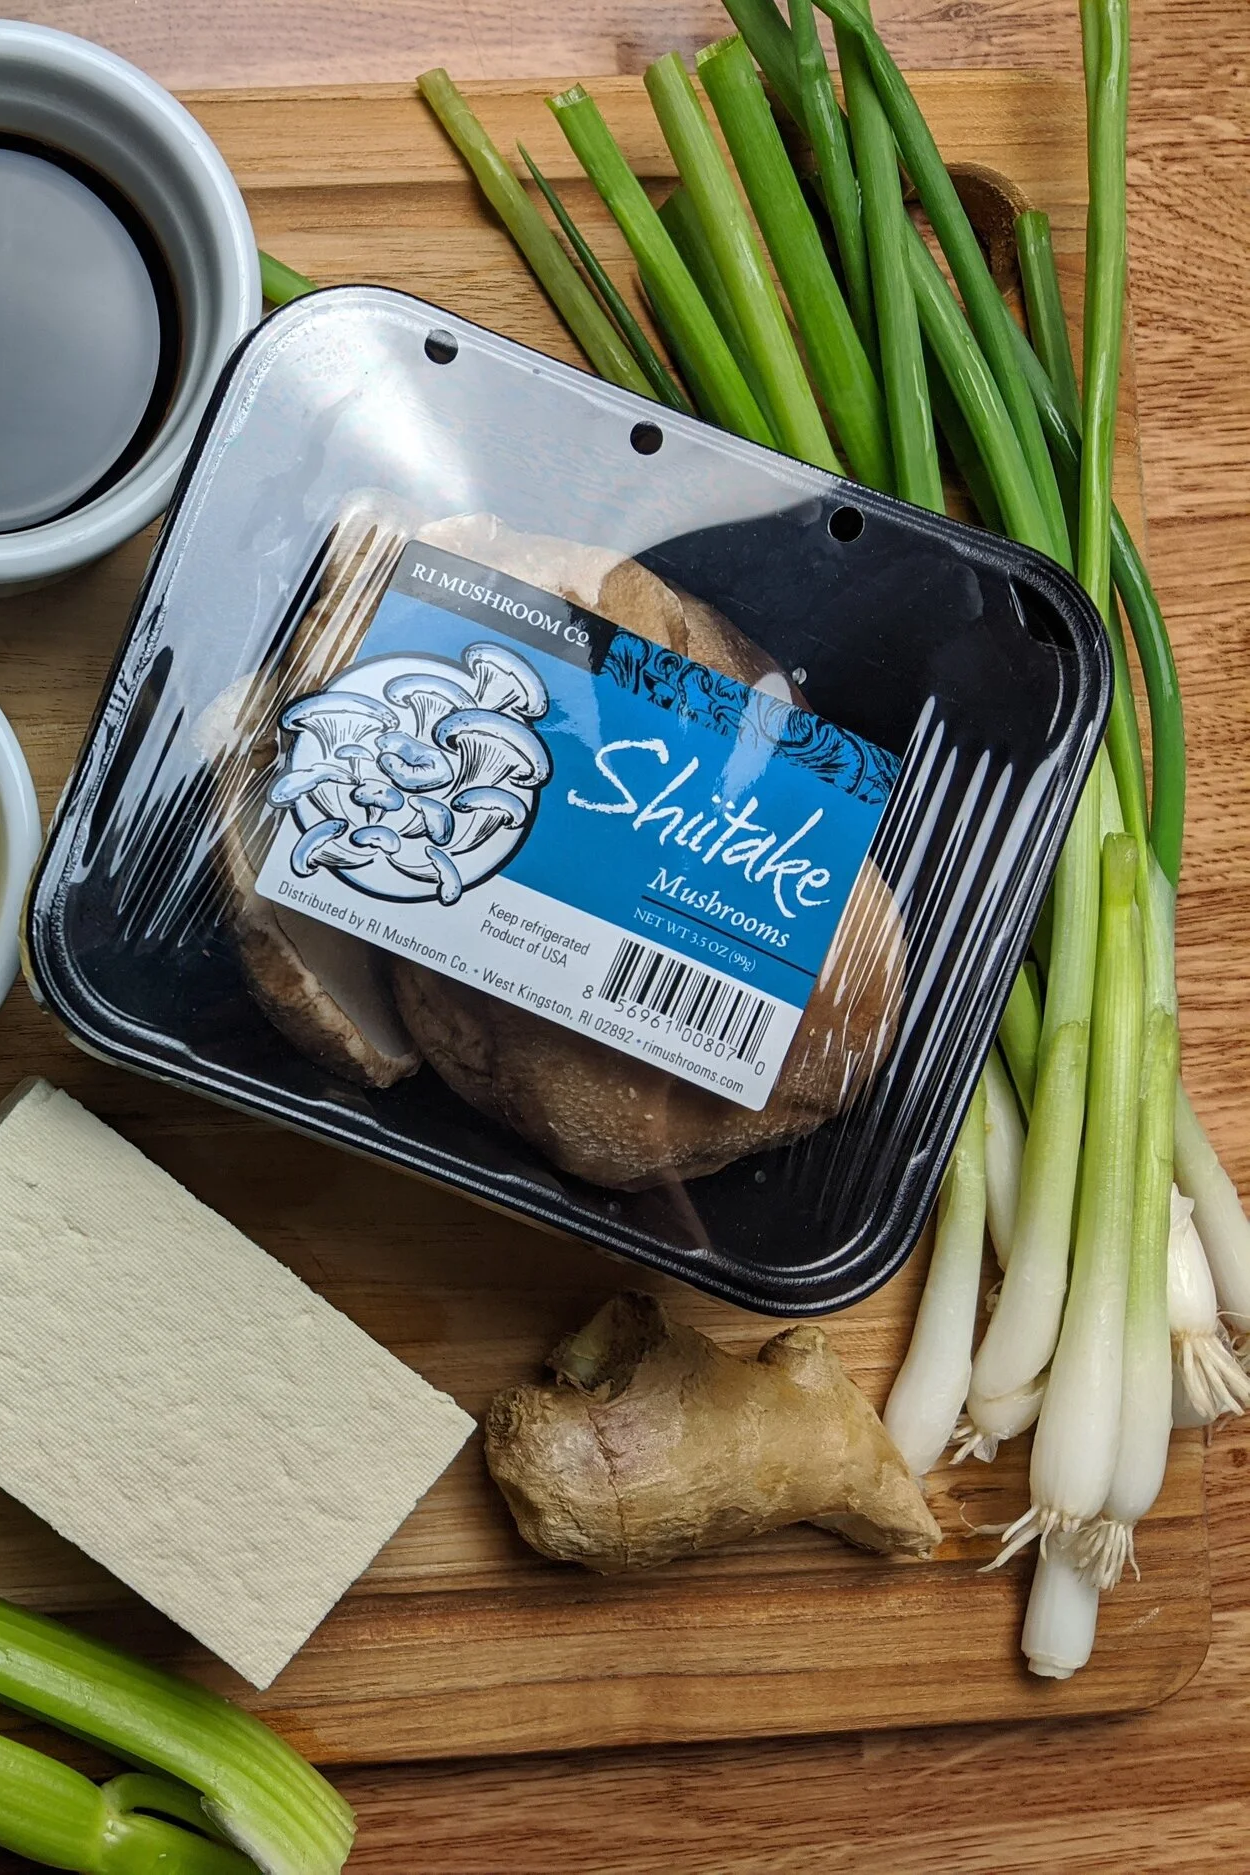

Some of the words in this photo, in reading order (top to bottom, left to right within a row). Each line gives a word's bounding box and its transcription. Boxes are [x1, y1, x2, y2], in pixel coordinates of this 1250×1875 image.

[411, 563, 437, 584] RI
[438, 572, 562, 635] MUSHROOM
[567, 738, 830, 918] Shiitake
[480, 920, 525, 949] Product
[526, 939, 542, 954] of
[542, 945, 567, 967] USA
[488, 902, 519, 926] Keep
[520, 917, 591, 956] refrigerated
[633, 907, 664, 930] NET
[666, 921, 689, 939] WT
[689, 931, 706, 948] 3.5
[707, 939, 728, 958] OZ
[728, 948, 756, 973] (99g)
[647, 867, 790, 948] Mushrooms
[278, 881, 347, 920] Distributed
[349, 910, 365, 930] by
[366, 918, 380, 934] RI
[382, 925, 447, 964] Mushroom
[450, 955, 469, 974] Co.
[482, 967, 515, 994] West
[516, 983, 574, 1021] Kingston,
[578, 1010, 594, 1027] RI
[594, 1019, 635, 1044] 02892
[642, 1039, 744, 1094] rimushrooms.com
[582, 984, 594, 999] 8
[614, 998, 673, 1034] 56961
[681, 1028, 737, 1062] 00807
[755, 1060, 765, 1076] 0
